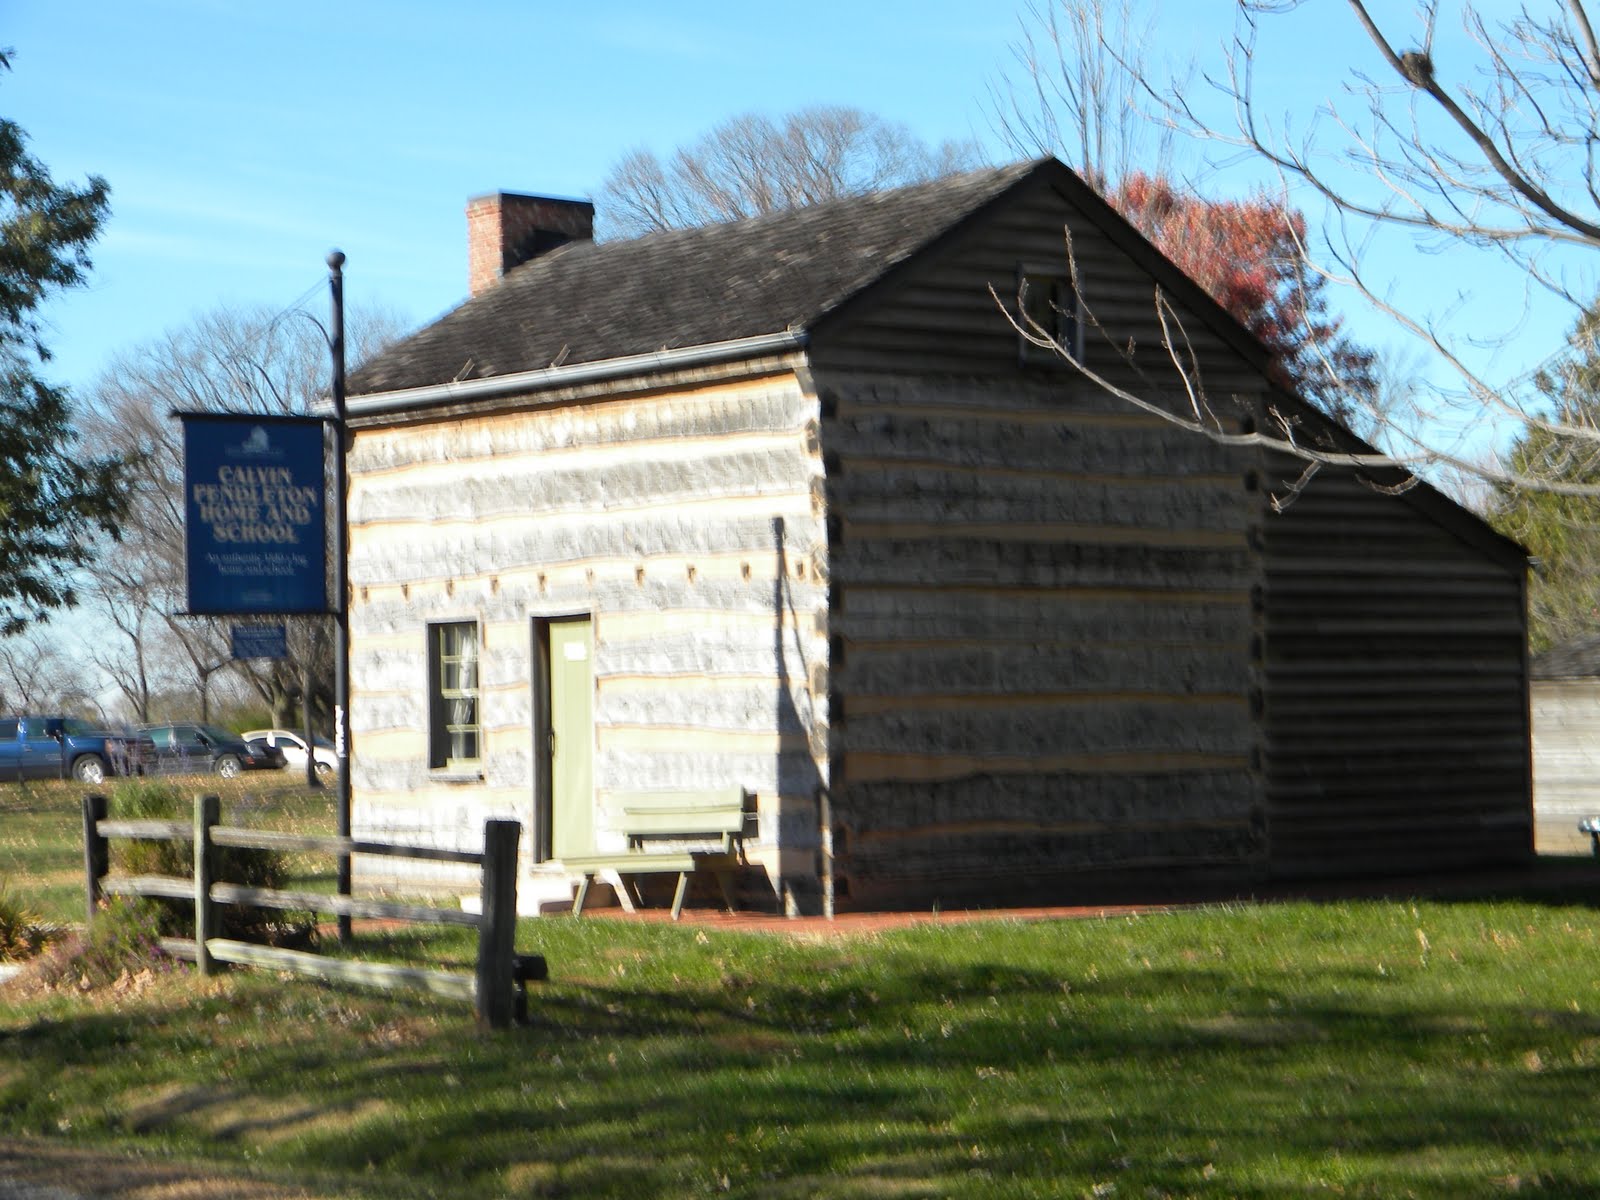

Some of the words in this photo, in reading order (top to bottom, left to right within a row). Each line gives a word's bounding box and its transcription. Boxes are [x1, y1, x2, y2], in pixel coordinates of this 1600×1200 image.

[218, 465, 293, 486] CALVIN
[193, 484, 318, 506] PENDLETON
[200, 503, 260, 523] HOME
[267, 504, 312, 525] AND
[213, 521, 300, 544] SCHOOL
